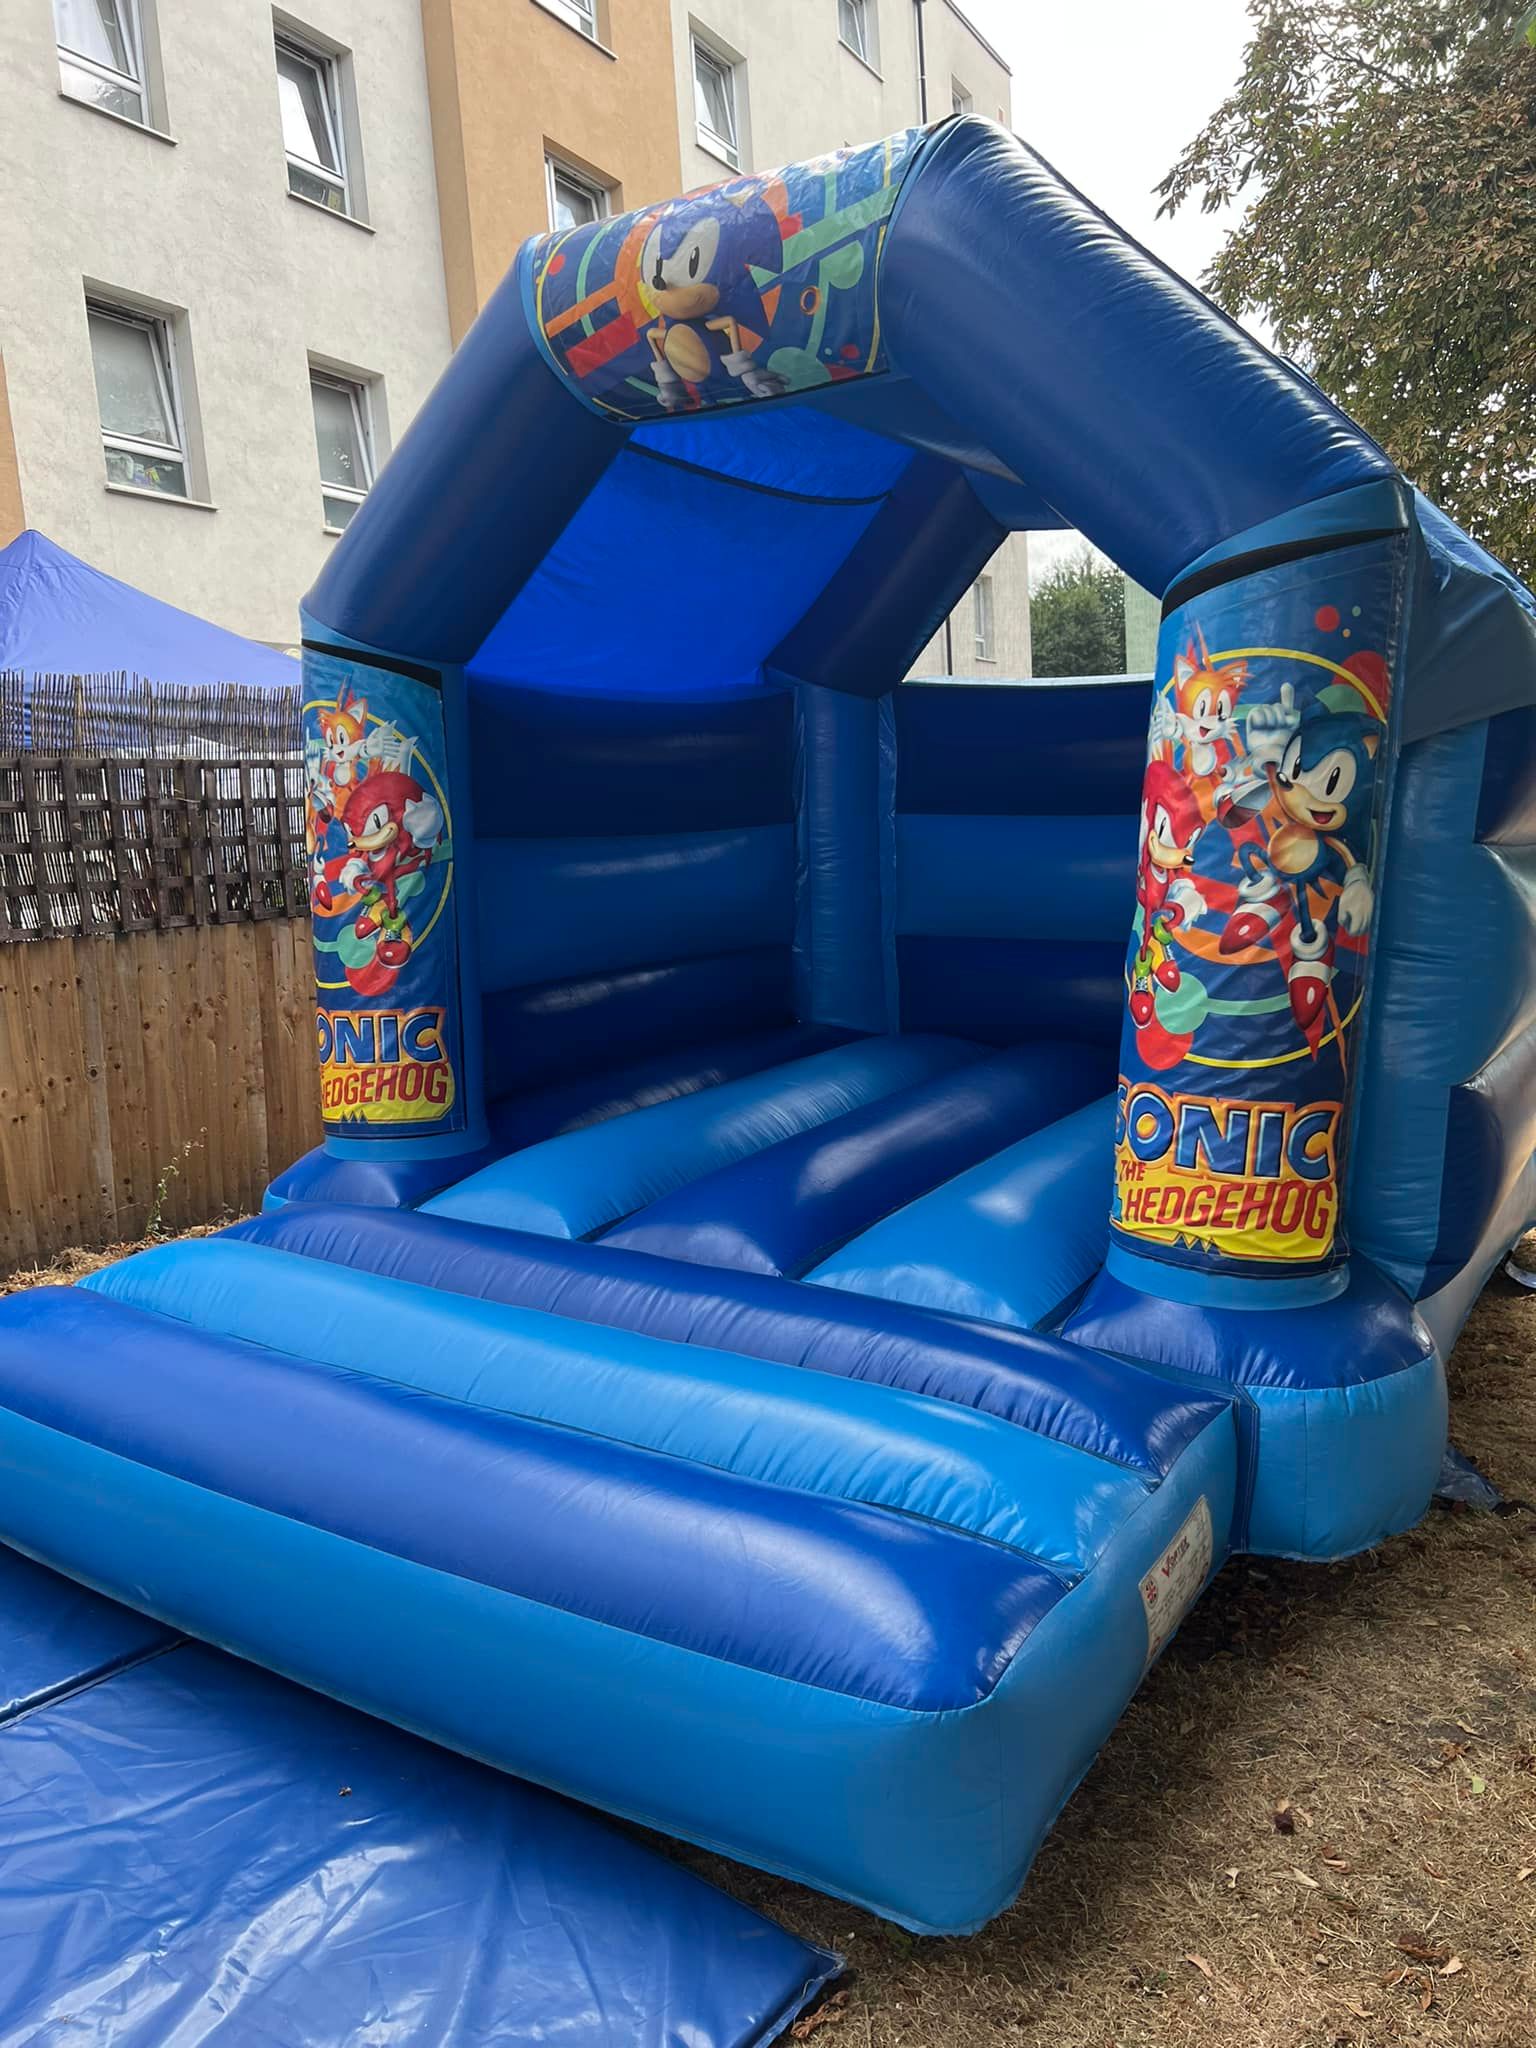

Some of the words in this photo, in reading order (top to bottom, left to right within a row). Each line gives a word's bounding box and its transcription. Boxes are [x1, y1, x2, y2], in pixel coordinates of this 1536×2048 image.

[316, 1011, 445, 1065] ONIC
[321, 1063, 449, 1108] EDGEHOG
[1119, 1159, 1147, 1182] THE
[1125, 1180, 1333, 1239] HEDGEHOG
